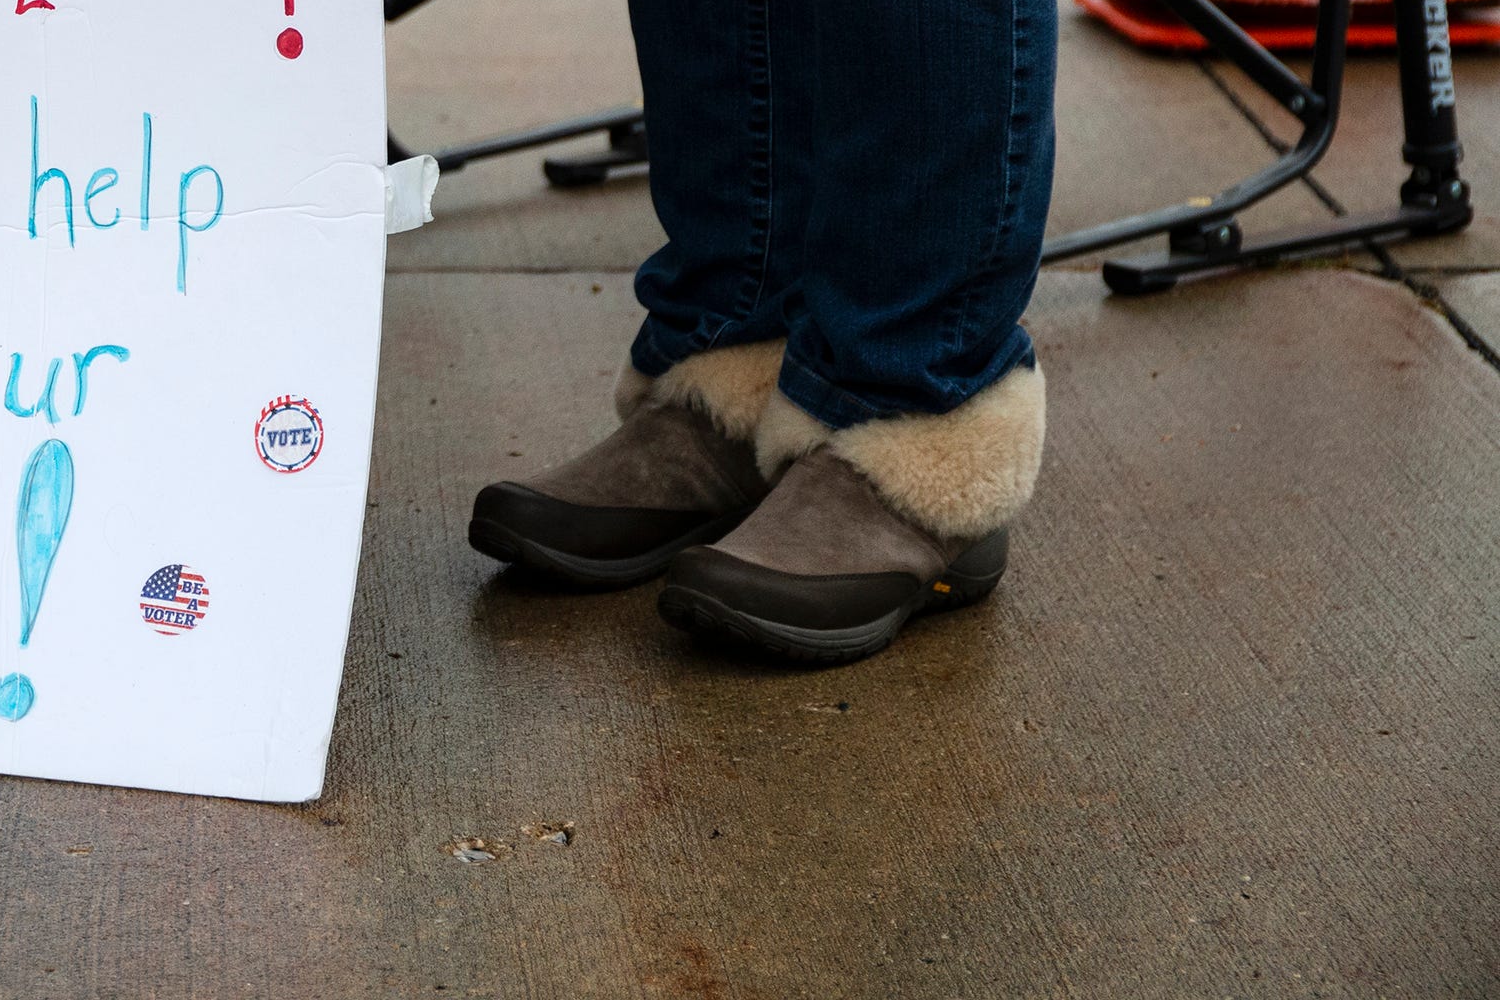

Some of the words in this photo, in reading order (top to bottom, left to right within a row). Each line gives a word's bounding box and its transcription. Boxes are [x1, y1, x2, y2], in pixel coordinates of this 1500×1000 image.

[27, 94, 226, 296] help
[267, 427, 312, 448] VOTE
[181, 580, 204, 595] BE
[187, 598, 198, 611] A
[144, 607, 196, 626] VOTER
